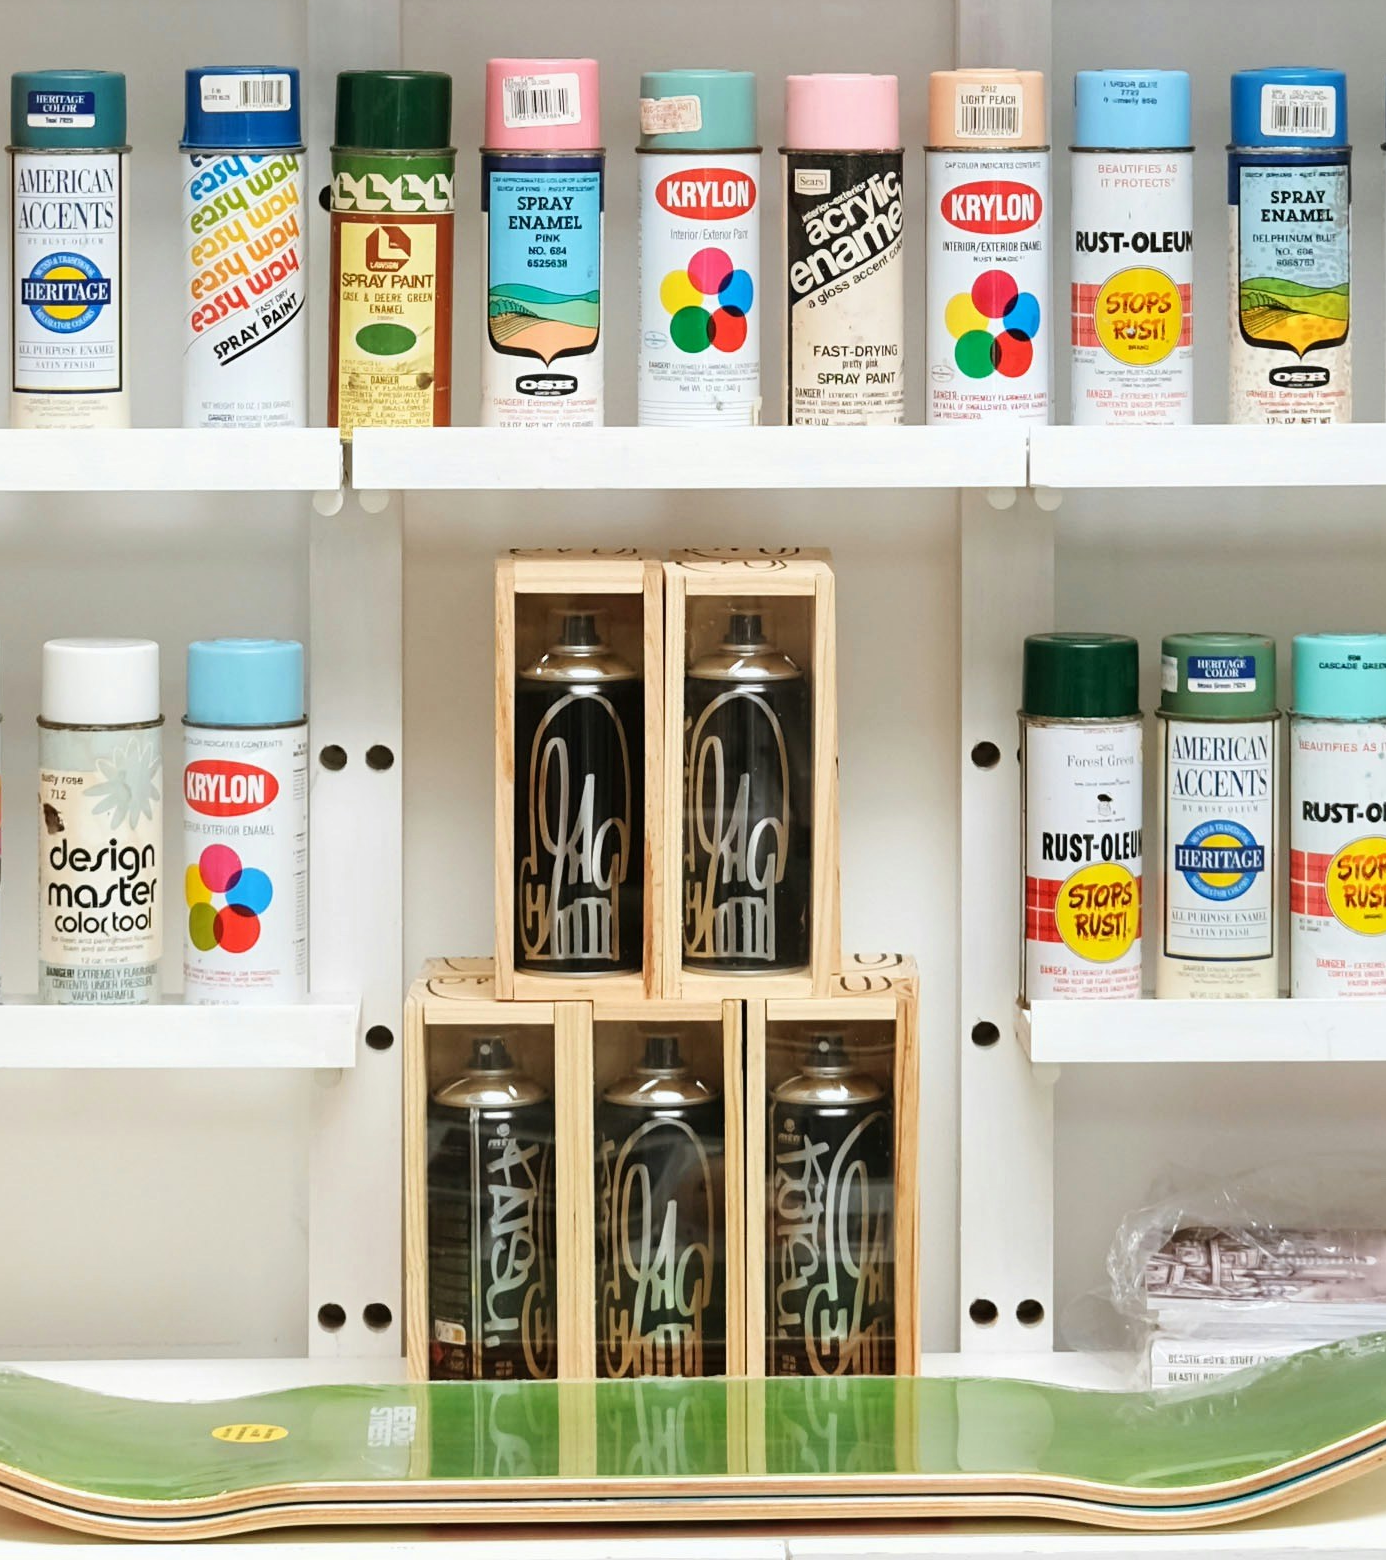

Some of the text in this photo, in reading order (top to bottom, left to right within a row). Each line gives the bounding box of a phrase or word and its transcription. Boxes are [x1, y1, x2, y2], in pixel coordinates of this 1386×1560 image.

[960, 94, 1016, 105] LIGHT PEACH
[19, 201, 114, 230] ACCENTS
[804, 168, 900, 245] acrylic
[536, 232, 560, 241] PINK
[341, 274, 434, 289] SPRAY PAINT
[213, 324, 260, 361] SPRAY
[813, 345, 897, 356] FAST-DRYING
[1319, 661, 1357, 670] CASCADE
[186, 773, 264, 803] KRYLON
[48, 877, 157, 907] master
